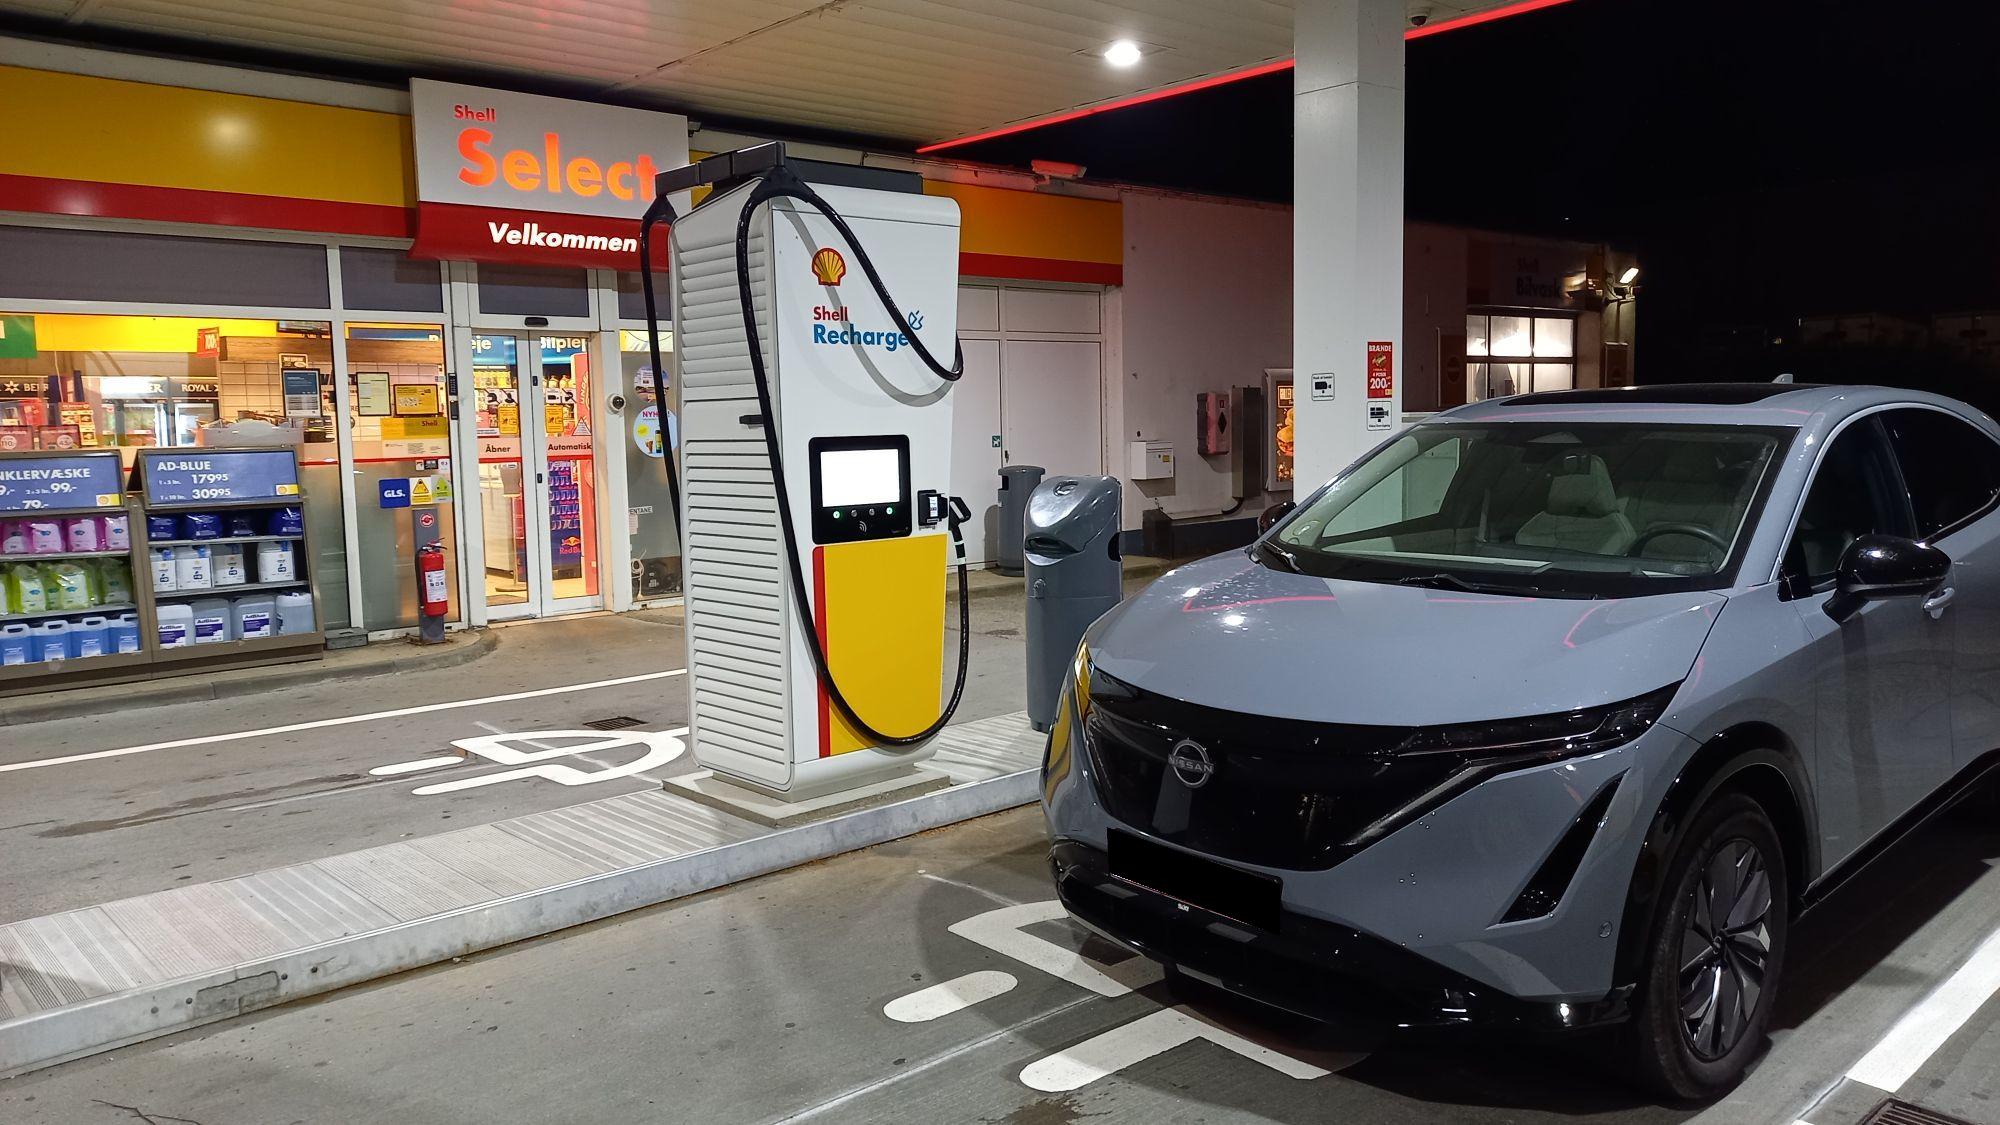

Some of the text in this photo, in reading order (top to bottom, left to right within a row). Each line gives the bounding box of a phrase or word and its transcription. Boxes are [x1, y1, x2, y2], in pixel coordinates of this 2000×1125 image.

[454, 104, 496, 122] Shell
[457, 127, 657, 202] Select
[488, 222, 638, 252] Velkommen
[813, 306, 849, 321] Shell
[813, 323, 909, 351] Recharge
[181, 384, 212, 393] ROYAL
[485, 444, 511, 453] Åbner
[547, 443, 593, 451] Automatisk
[157, 461, 211, 471] AD-BLUE
[1168, 753, 1214, 774] NISSAN
